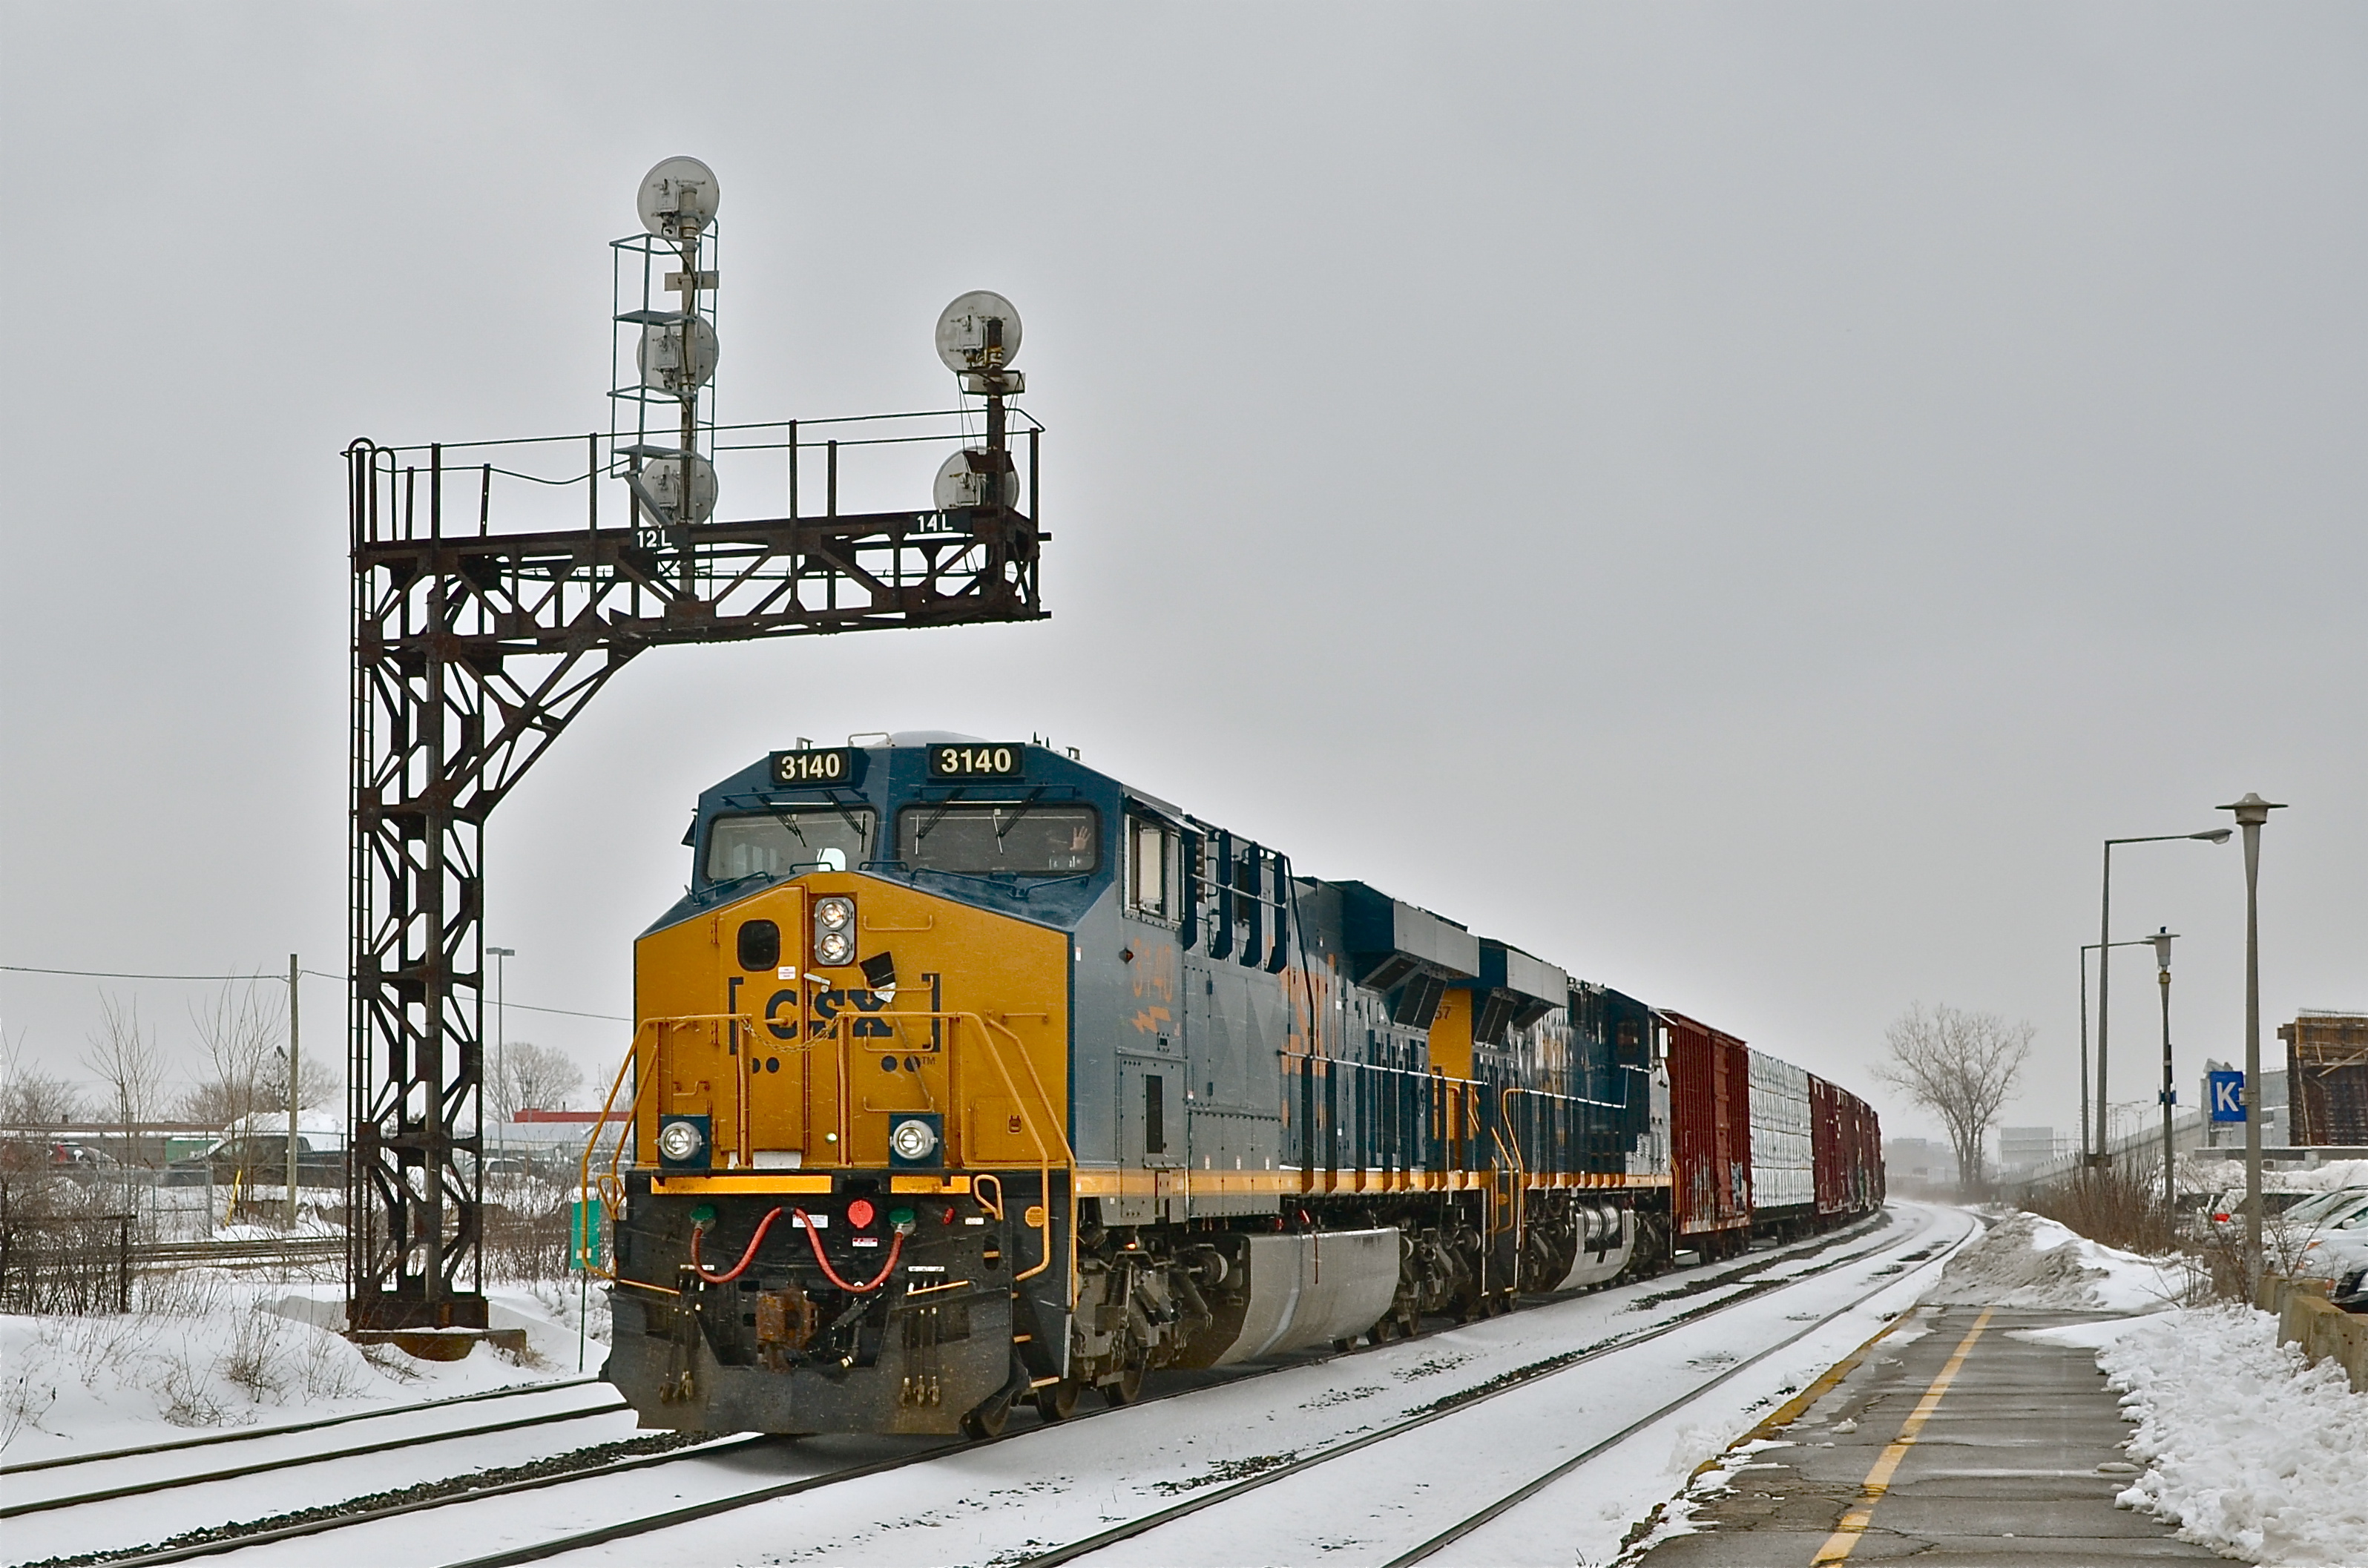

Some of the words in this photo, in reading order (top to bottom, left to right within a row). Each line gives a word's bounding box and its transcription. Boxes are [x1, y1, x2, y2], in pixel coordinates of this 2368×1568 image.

[780, 753, 841, 780] 3140
[941, 748, 1012, 773] 3140
[764, 988, 893, 1039] CSX
[2216, 1081, 2239, 1111] K
